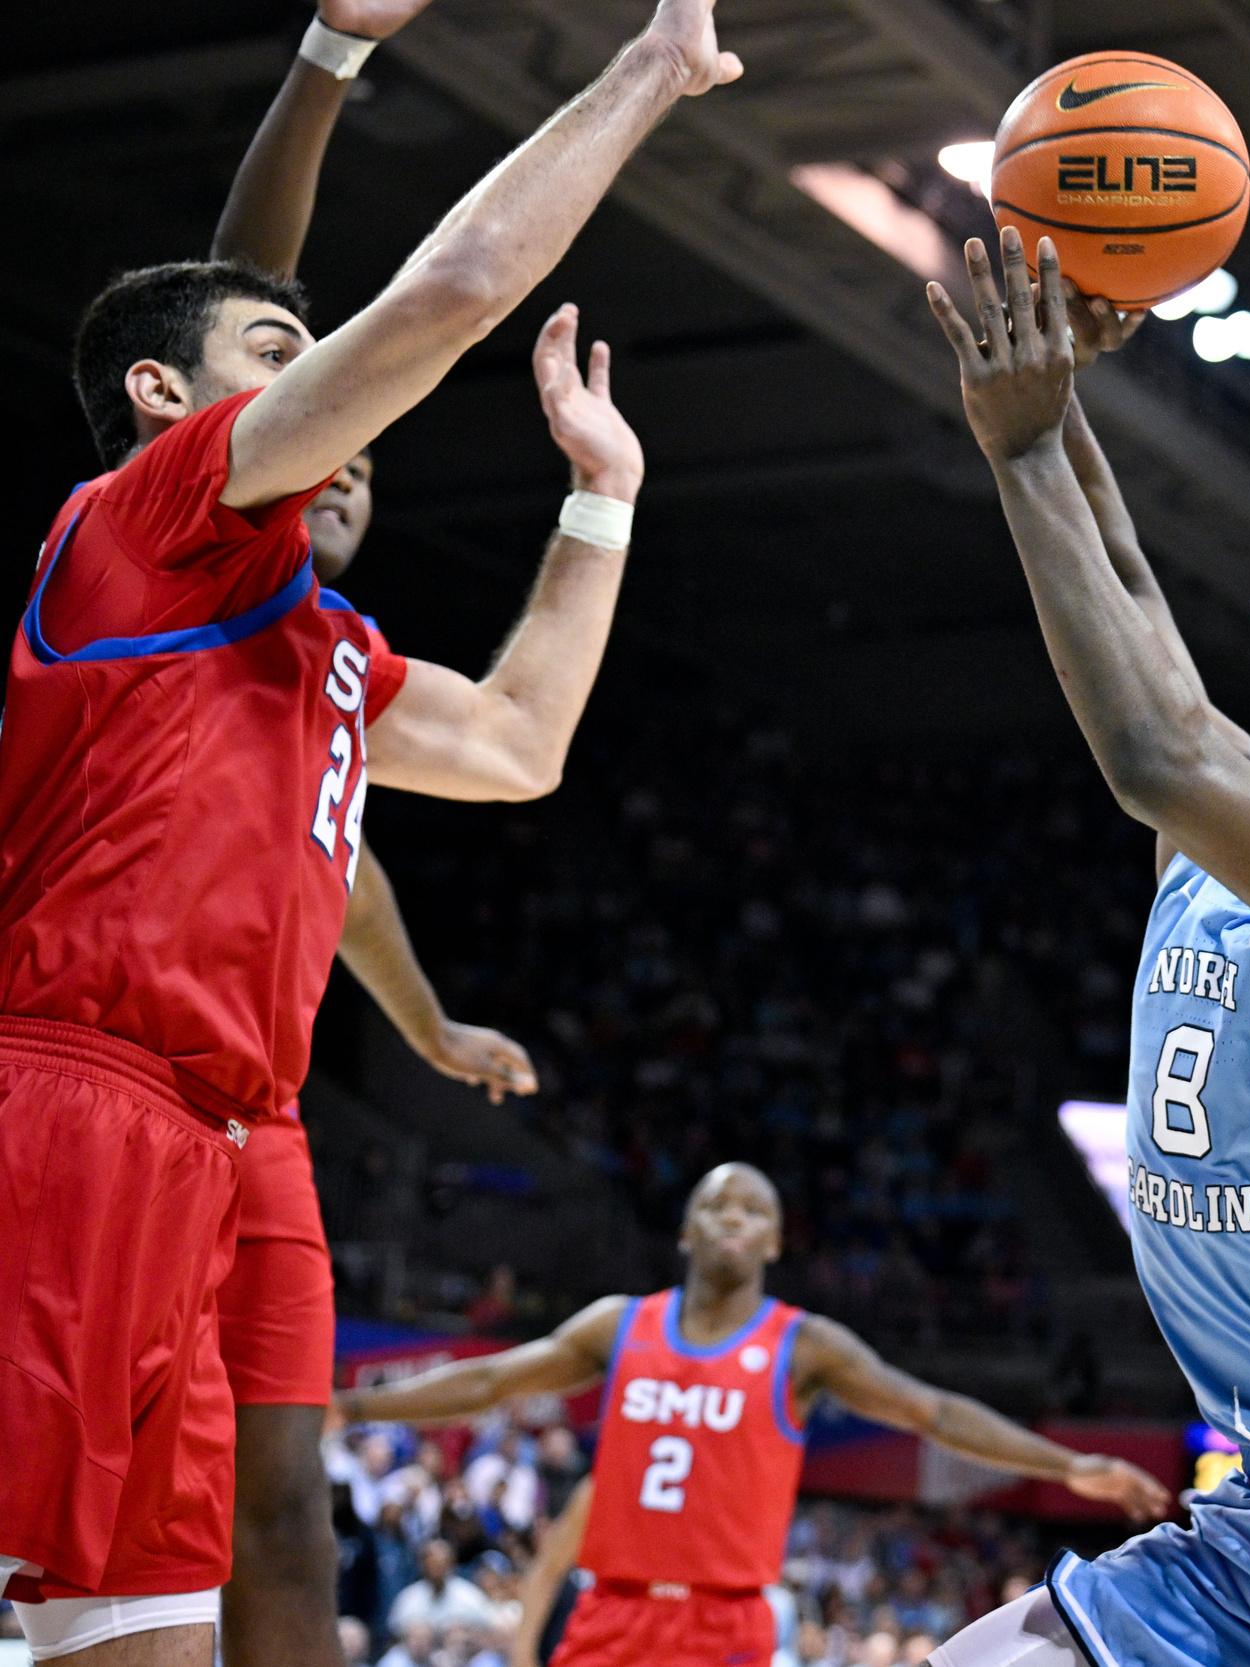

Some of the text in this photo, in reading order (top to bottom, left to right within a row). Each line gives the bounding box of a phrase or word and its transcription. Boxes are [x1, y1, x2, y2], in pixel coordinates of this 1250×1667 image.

[1058, 155, 1197, 192] ELITE
[1149, 947, 1239, 1012] NORH
[1151, 1022, 1215, 1160] 8
[621, 1377, 747, 1433] SMU
[638, 1435, 694, 1513] 2
